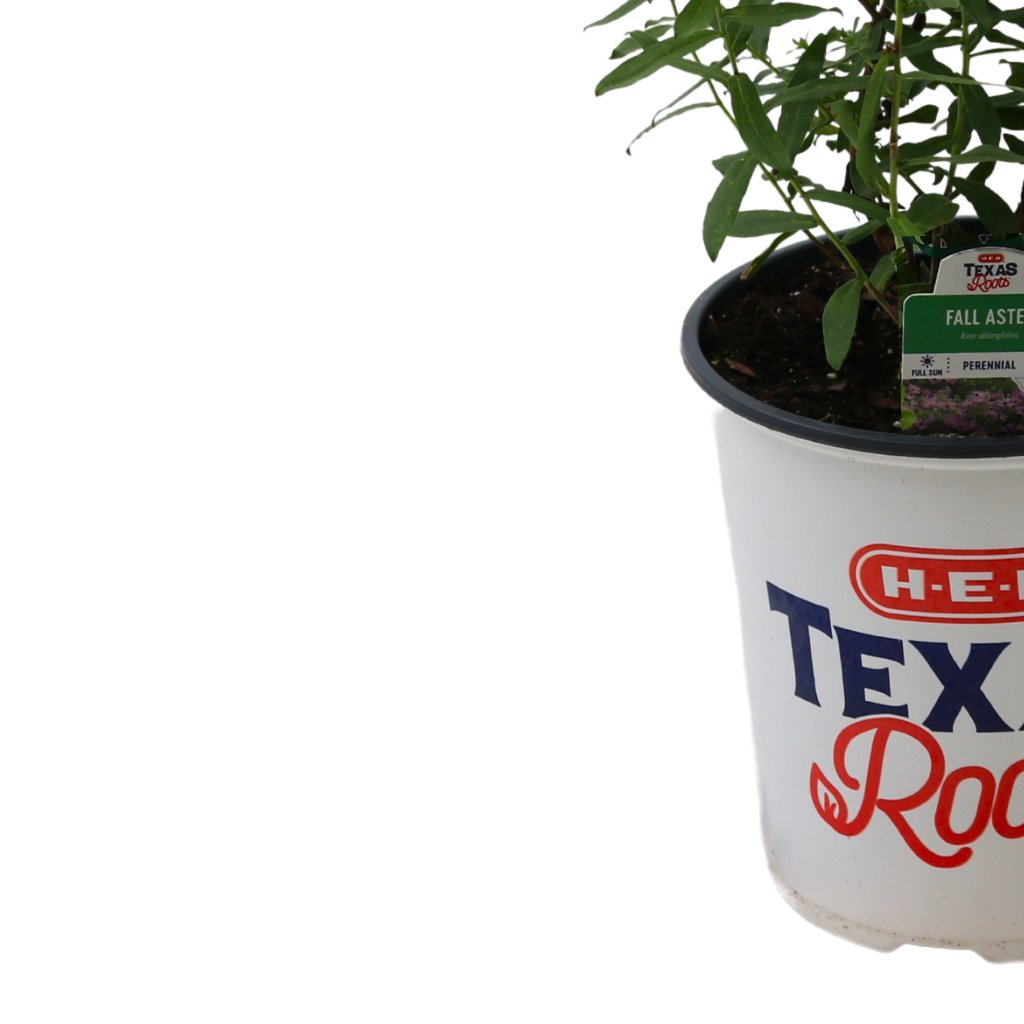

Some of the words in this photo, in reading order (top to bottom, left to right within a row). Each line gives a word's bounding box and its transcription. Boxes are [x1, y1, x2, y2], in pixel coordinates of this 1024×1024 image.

[964, 263, 1018, 277] TEXAS
[967, 274, 1010, 292] Roots
[946, 309, 980, 326] FALL
[960, 332, 977, 340] Aster
[963, 360, 1016, 371] PERENNIAL
